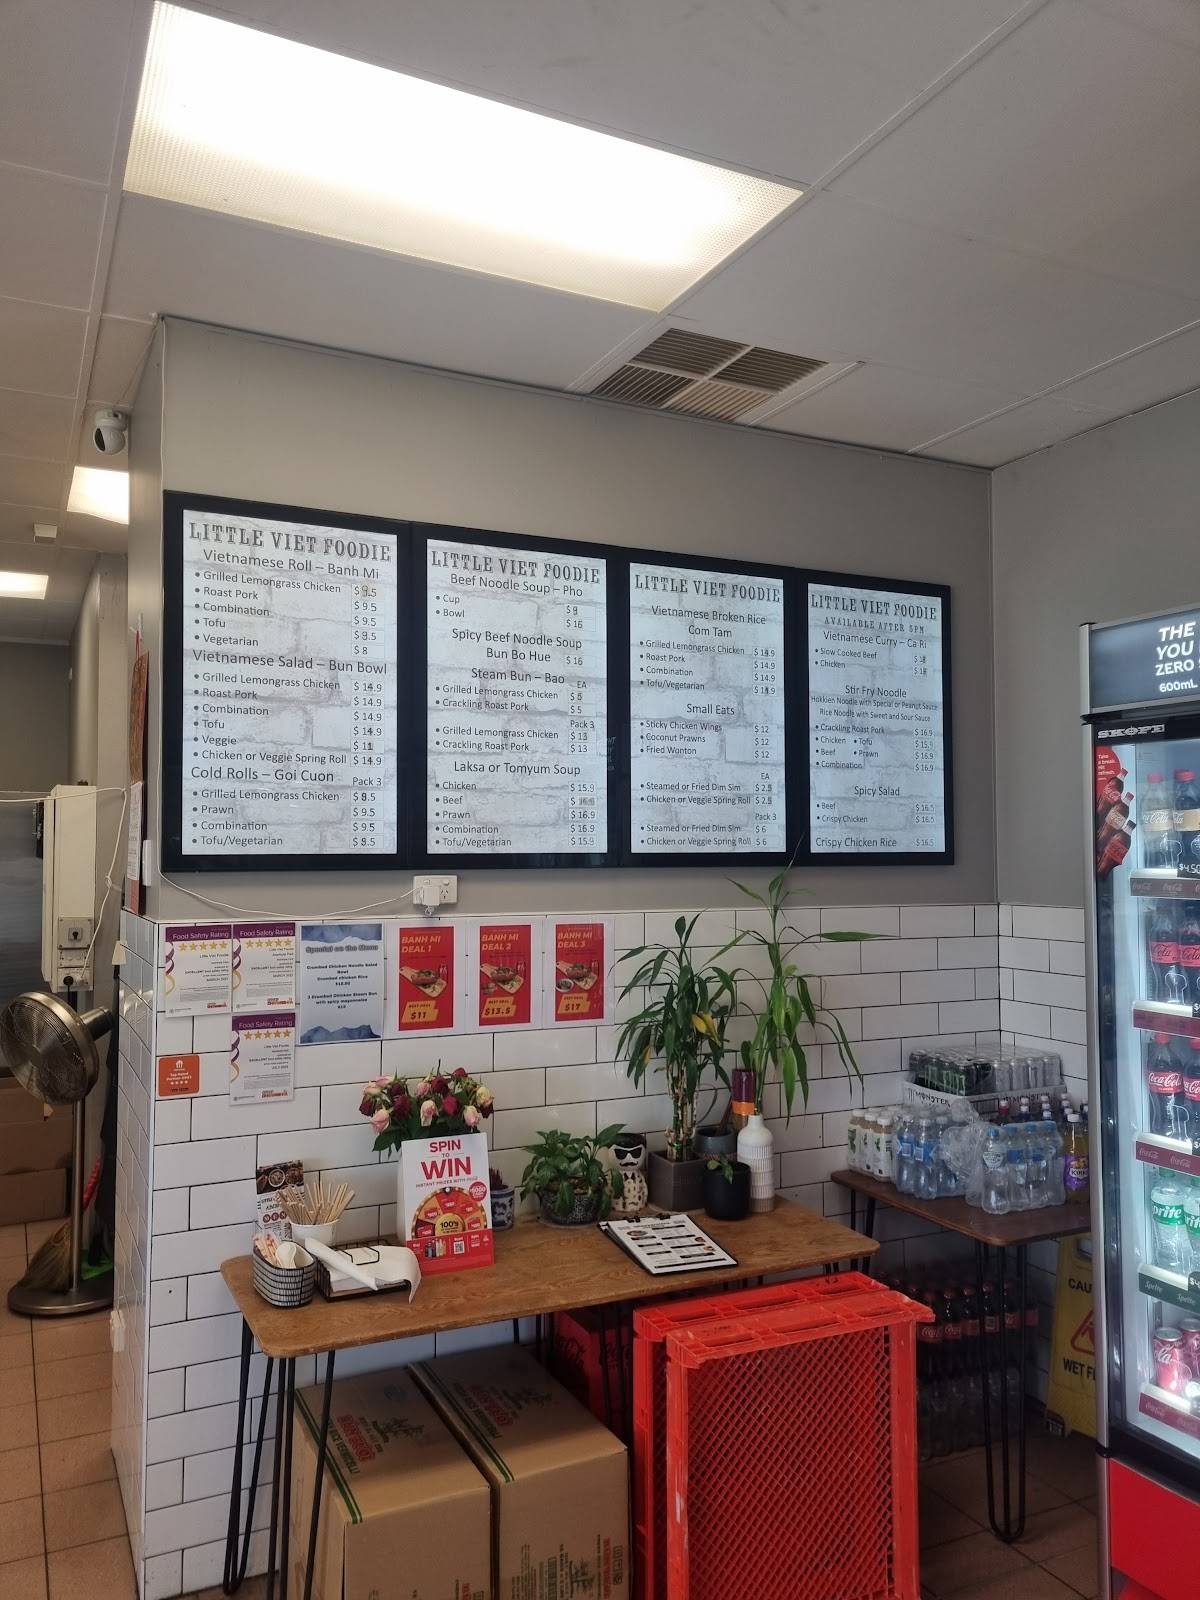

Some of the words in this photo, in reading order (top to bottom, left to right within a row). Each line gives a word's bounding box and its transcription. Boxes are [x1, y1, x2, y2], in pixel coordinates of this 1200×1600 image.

[190, 522, 263, 547] LITTLE
[272, 532, 316, 553] VIET
[324, 538, 391, 562] FOODIE
[203, 549, 284, 568] Vietnamese
[288, 559, 312, 571] Roll
[328, 563, 358, 577] Banh
[364, 568, 378, 579] Mi
[432, 551, 493, 572] LITTLE
[499, 559, 537, 577] VIET
[544, 563, 600, 583] FOODIE
[204, 571, 238, 582] Grilled
[242, 572, 300, 589] Lemongrass
[304, 581, 341, 592] Chicken
[451, 574, 476, 586] Beef
[480, 577, 520, 590] Noodle
[523, 582, 550, 595] Soup
[563, 586, 582, 596] Pho
[635, 575, 688, 593] LITTLE
[694, 581, 726, 597] VIET
[732, 584, 780, 602] FOODIE
[204, 587, 232, 598] Roast
[236, 590, 258, 600] Pork
[443, 595, 460, 604] Cup
[203, 603, 269, 616] Combination
[443, 609, 465, 618] Bowl
[812, 594, 856, 611] LITTLE
[861, 600, 890, 615] VIET
[895, 604, 936, 620] FOODIE
[652, 606, 708, 619] Vietnamese
[712, 611, 744, 623] Broken
[748, 614, 766, 624] Rice
[204, 618, 226, 628] Tofu
[825, 617, 874, 629] AVAILABLE
[879, 622, 904, 631] AFTER
[452, 628, 481, 642] Spicy
[486, 631, 510, 643] Beef
[513, 633, 552, 646] Noodle
[556, 637, 582, 649] Soup
[689, 625, 709, 636] Com
[712, 627, 732, 638] Tam
[1159, 622, 1196, 641] THE
[203, 634, 258, 647] Vegetarian
[824, 632, 873, 644] Vietnamese
[876, 636, 897, 648] Curry
[908, 639, 917, 648] Ca
[920, 640, 926, 648] Ri
[487, 648, 508, 659] Bun
[512, 650, 526, 660] Bo
[529, 651, 550, 661] Hue
[838, 649, 860, 657] Cooked
[1157, 641, 1194, 660] YOU
[193, 650, 274, 666] Vietnamese
[279, 656, 313, 669] Salad
[329, 660, 352, 672] Bun
[358, 662, 387, 673] Bowl
[1155, 659, 1194, 676] ZERO
[472, 668, 507, 681] Steam
[511, 671, 531, 682] Bun
[545, 673, 564, 683] Bao
[646, 679, 704, 691] Tofu/Vegetarian
[846, 685, 859, 694] Stir
[862, 686, 874, 696] Fry
[878, 688, 906, 697] Noodle
[1160, 679, 1198, 692] 600mL
[443, 699, 482, 710] Crackling
[485, 701, 508, 709] Roast
[511, 702, 528, 710] Pork
[687, 704, 712, 714] Small
[716, 705, 735, 715] Eats
[646, 721, 667, 730] Sticky
[670, 722, 697, 730] Chicken
[700, 723, 722, 732] Wings
[646, 733, 676, 741] Coconut
[202, 750, 242, 760] Chicken
[246, 753, 256, 761] or
[259, 752, 292, 764] Veggie
[295, 754, 326, 765] Spring
[329, 754, 347, 764] Roll
[192, 767, 222, 780] Cold
[227, 768, 258, 780] Rolls
[274, 769, 297, 782] Goi
[301, 770, 334, 782] Cuon
[454, 761, 484, 772] Laksa
[489, 764, 500, 772] or
[504, 762, 550, 775] Tomyum
[554, 764, 580, 776] Soup
[646, 782, 679, 790] Steamed
[691, 783, 709, 791] Fried
[854, 786, 876, 796] Spicy
[879, 787, 899, 795] Salad
[816, 838, 842, 848] Crispy
[845, 838, 877, 846] Chicken
[880, 838, 896, 846] Rice
[485, 1007, 510, 1015] $13.5
[916, 1091, 951, 1108] MONSTER
[430, 1139, 461, 1152] SPIN
[421, 1157, 471, 1180] WIN
[1152, 1204, 1182, 1219] prite
[1064, 1359, 1085, 1376] WET
